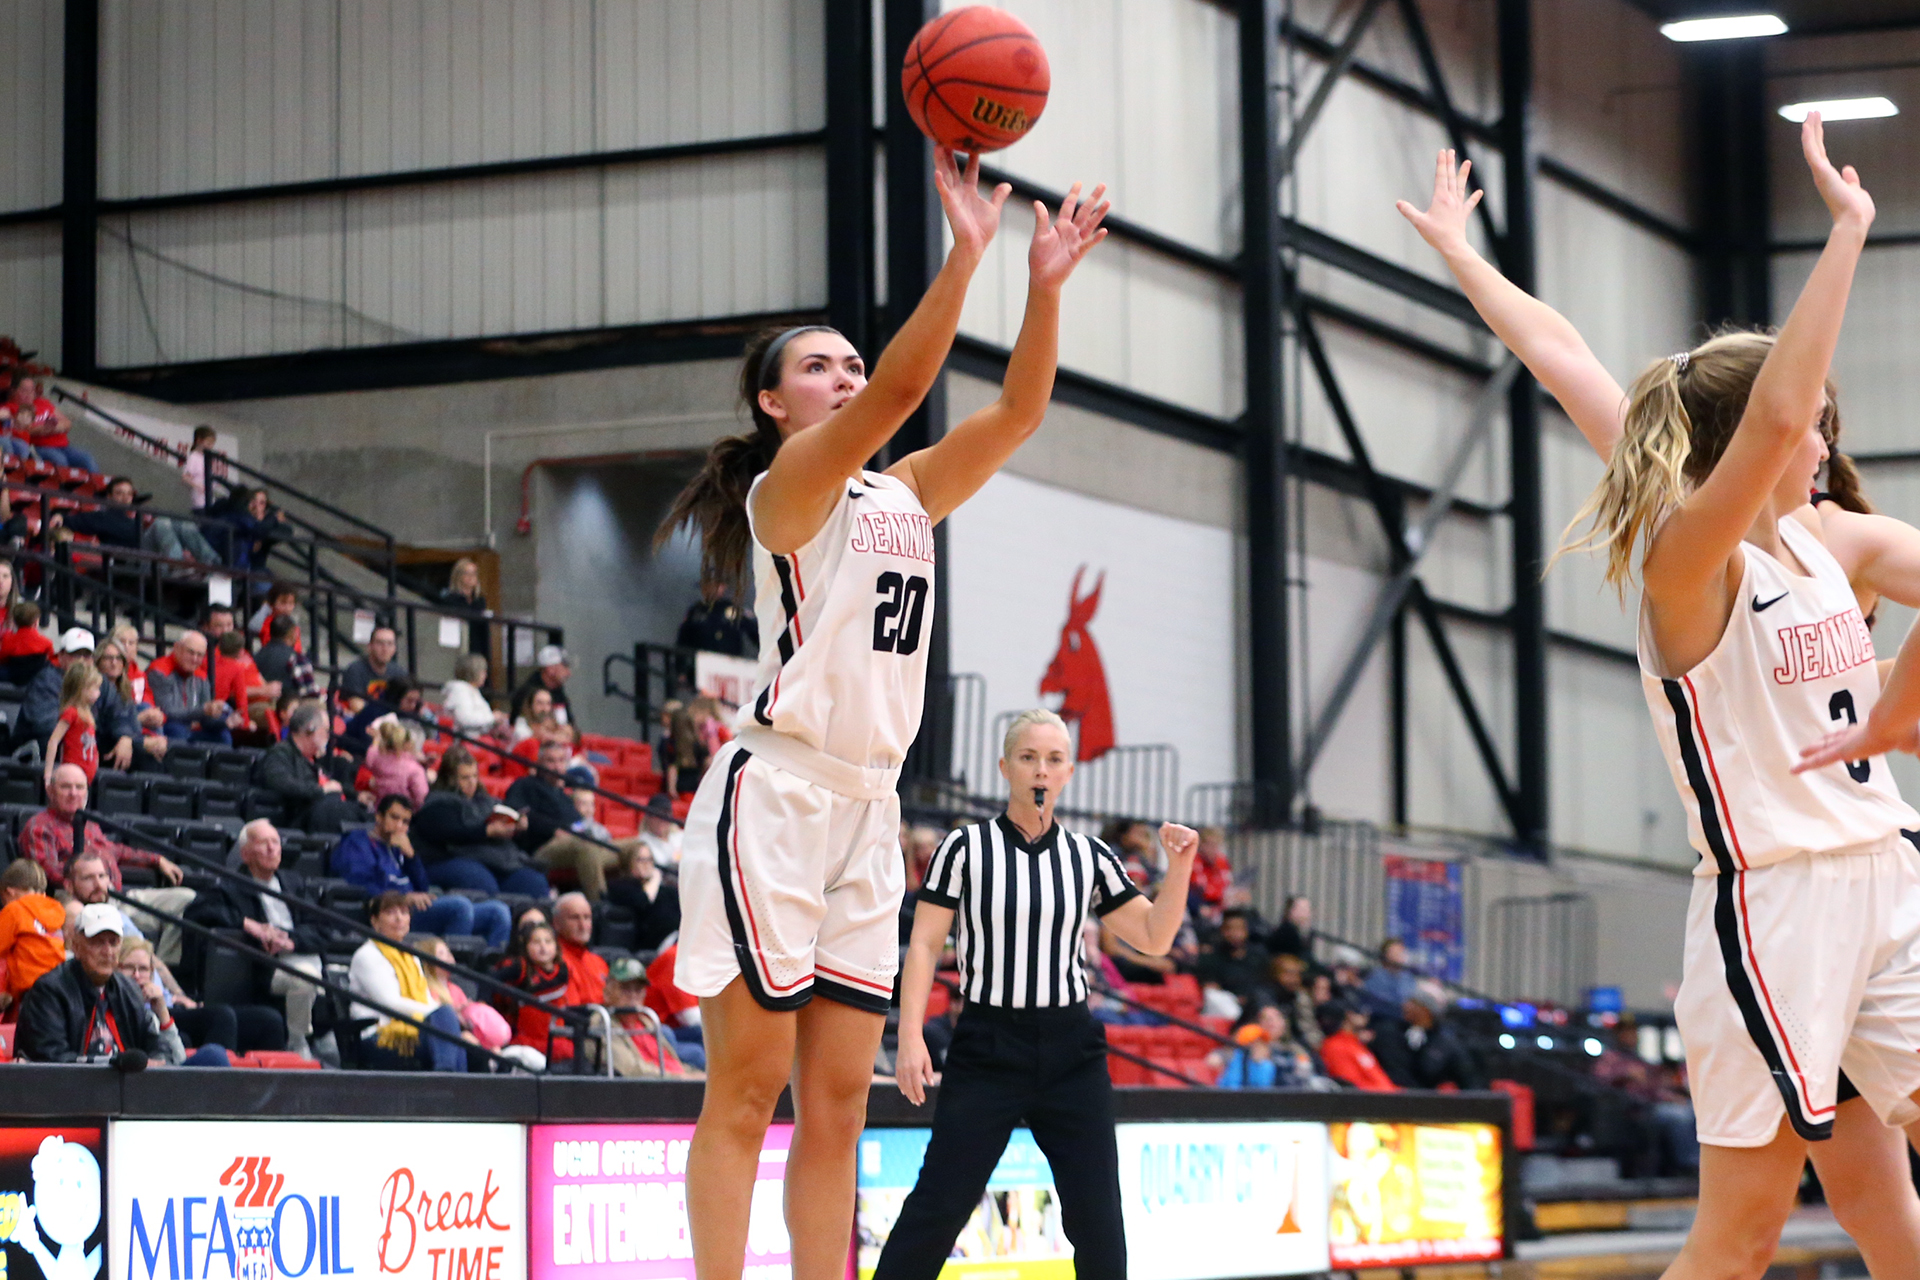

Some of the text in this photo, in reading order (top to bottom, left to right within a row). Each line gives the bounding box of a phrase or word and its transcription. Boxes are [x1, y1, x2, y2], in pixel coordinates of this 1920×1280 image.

[873, 571, 928, 656] 20
[601, 1139, 666, 1177] OFFICE
[127, 1193, 355, 1280] MFA OIL
[378, 1167, 511, 1274] Break
[427, 1246, 504, 1280] TIME
[553, 1181, 694, 1266] EXTENDE
